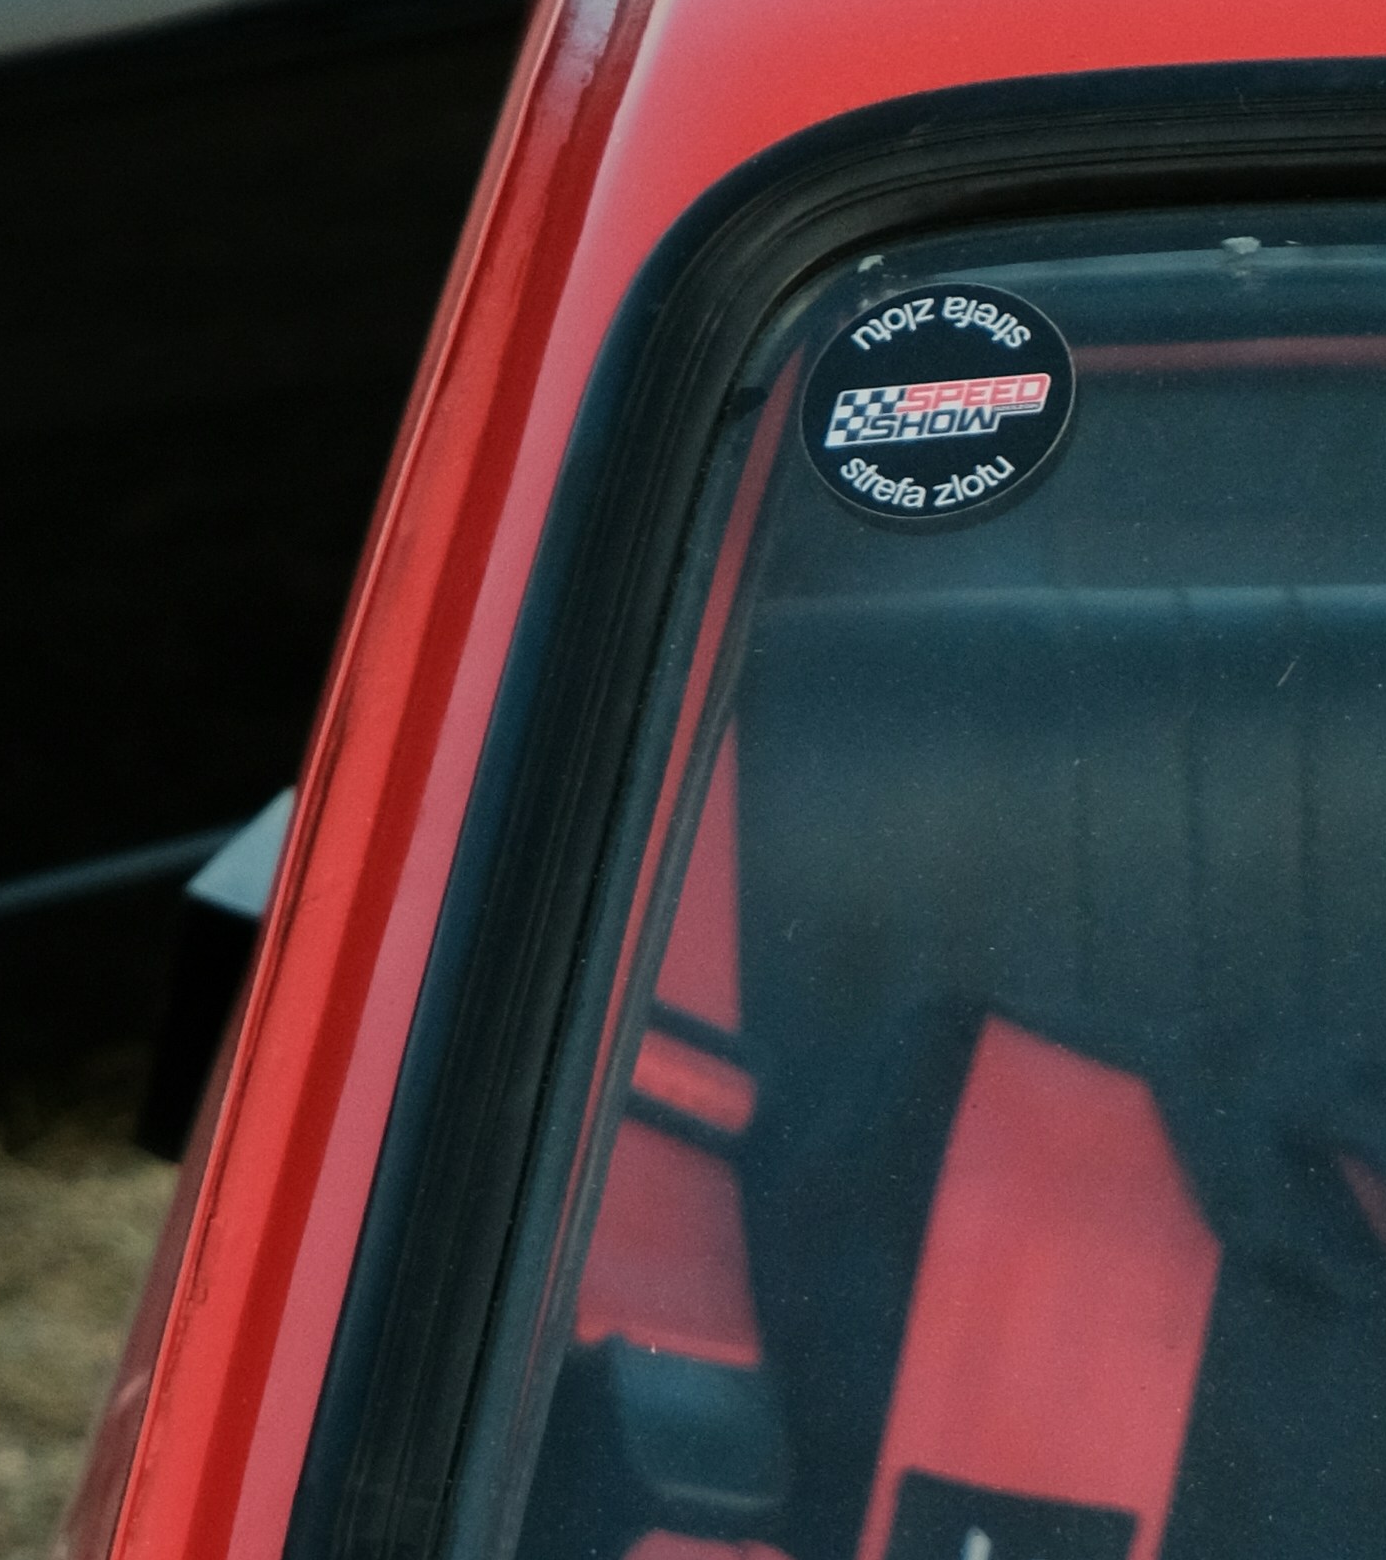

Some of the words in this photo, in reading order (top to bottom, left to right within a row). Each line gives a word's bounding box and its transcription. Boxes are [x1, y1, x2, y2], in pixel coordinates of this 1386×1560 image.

[850, 297, 935, 350] zlotu
[942, 295, 1031, 348] strefa
[896, 374, 1050, 413] SPEED
[860, 406, 1001, 439] SHOW
[840, 457, 926, 507] strefa
[933, 455, 1015, 506] zlotu
